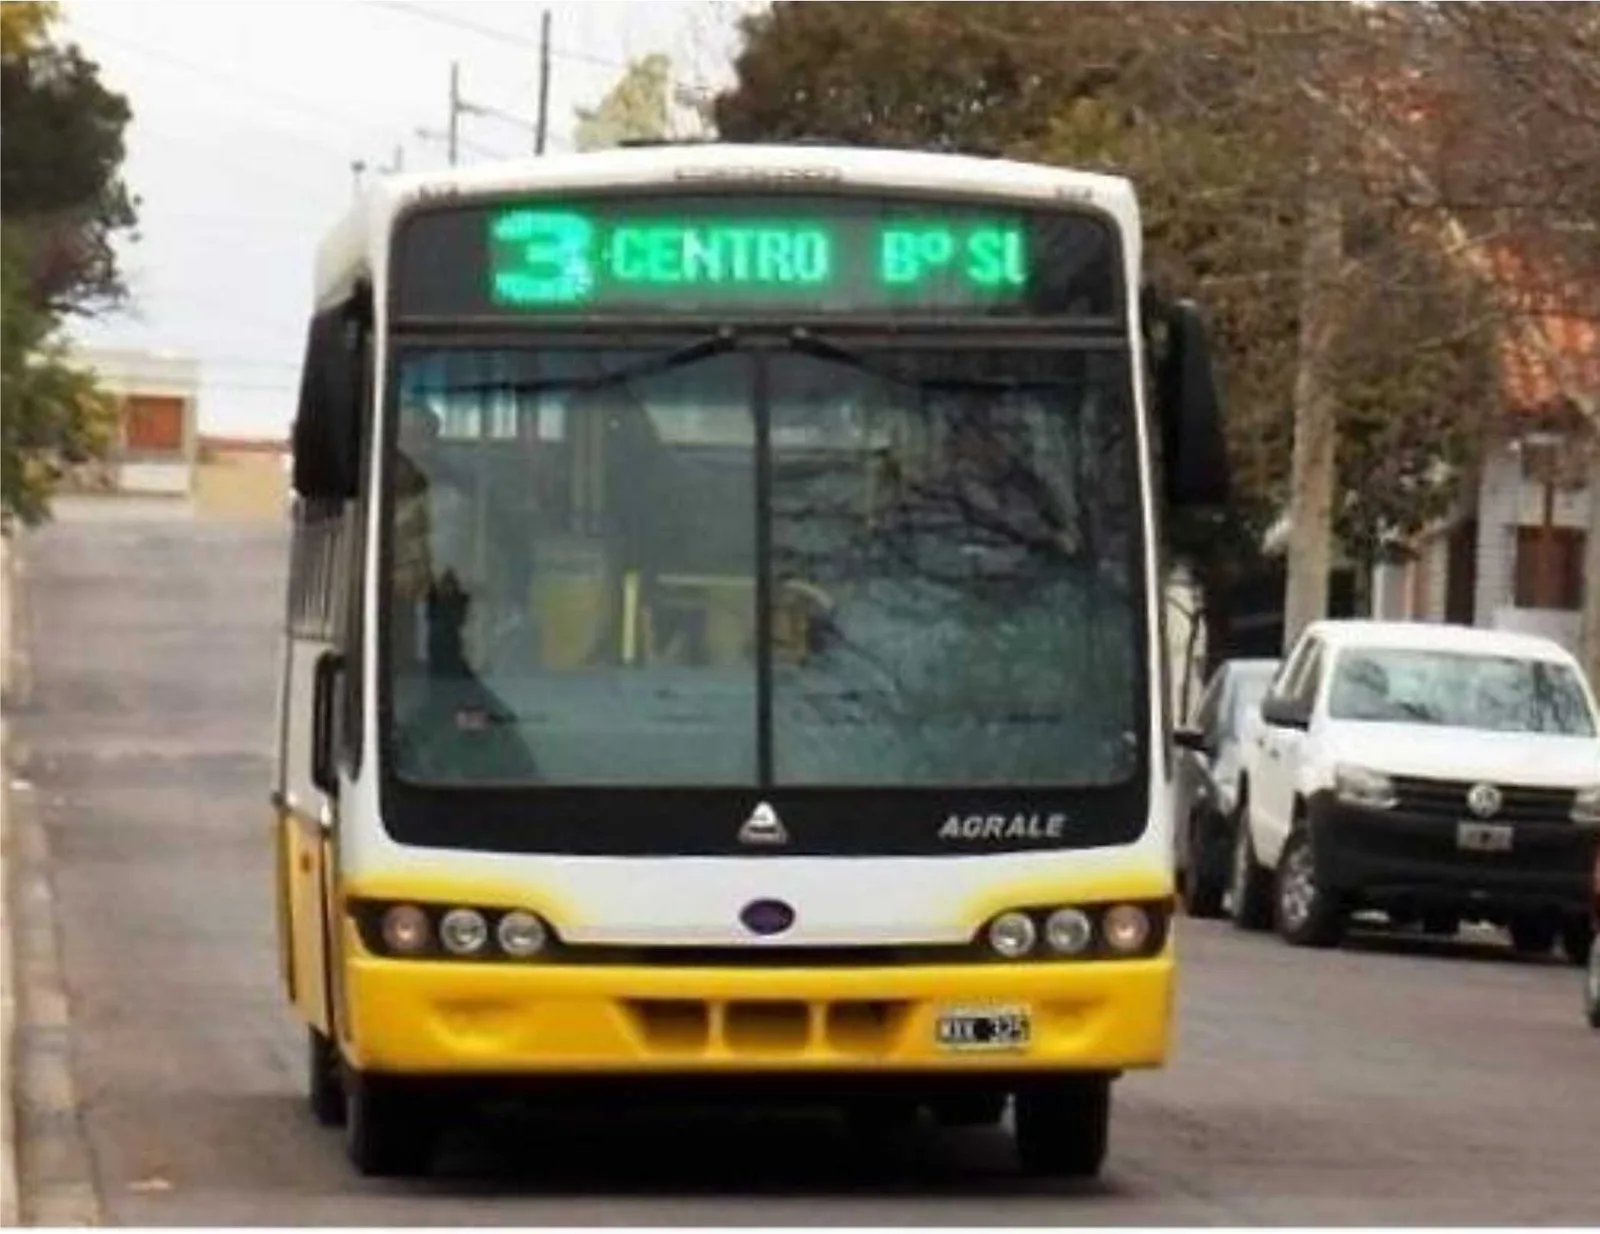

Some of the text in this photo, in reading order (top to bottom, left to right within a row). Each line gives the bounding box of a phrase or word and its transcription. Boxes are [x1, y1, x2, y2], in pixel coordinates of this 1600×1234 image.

[490, 208, 594, 304] 3
[611, 227, 828, 284] CENTRO
[938, 812, 1067, 840] AGRALE
